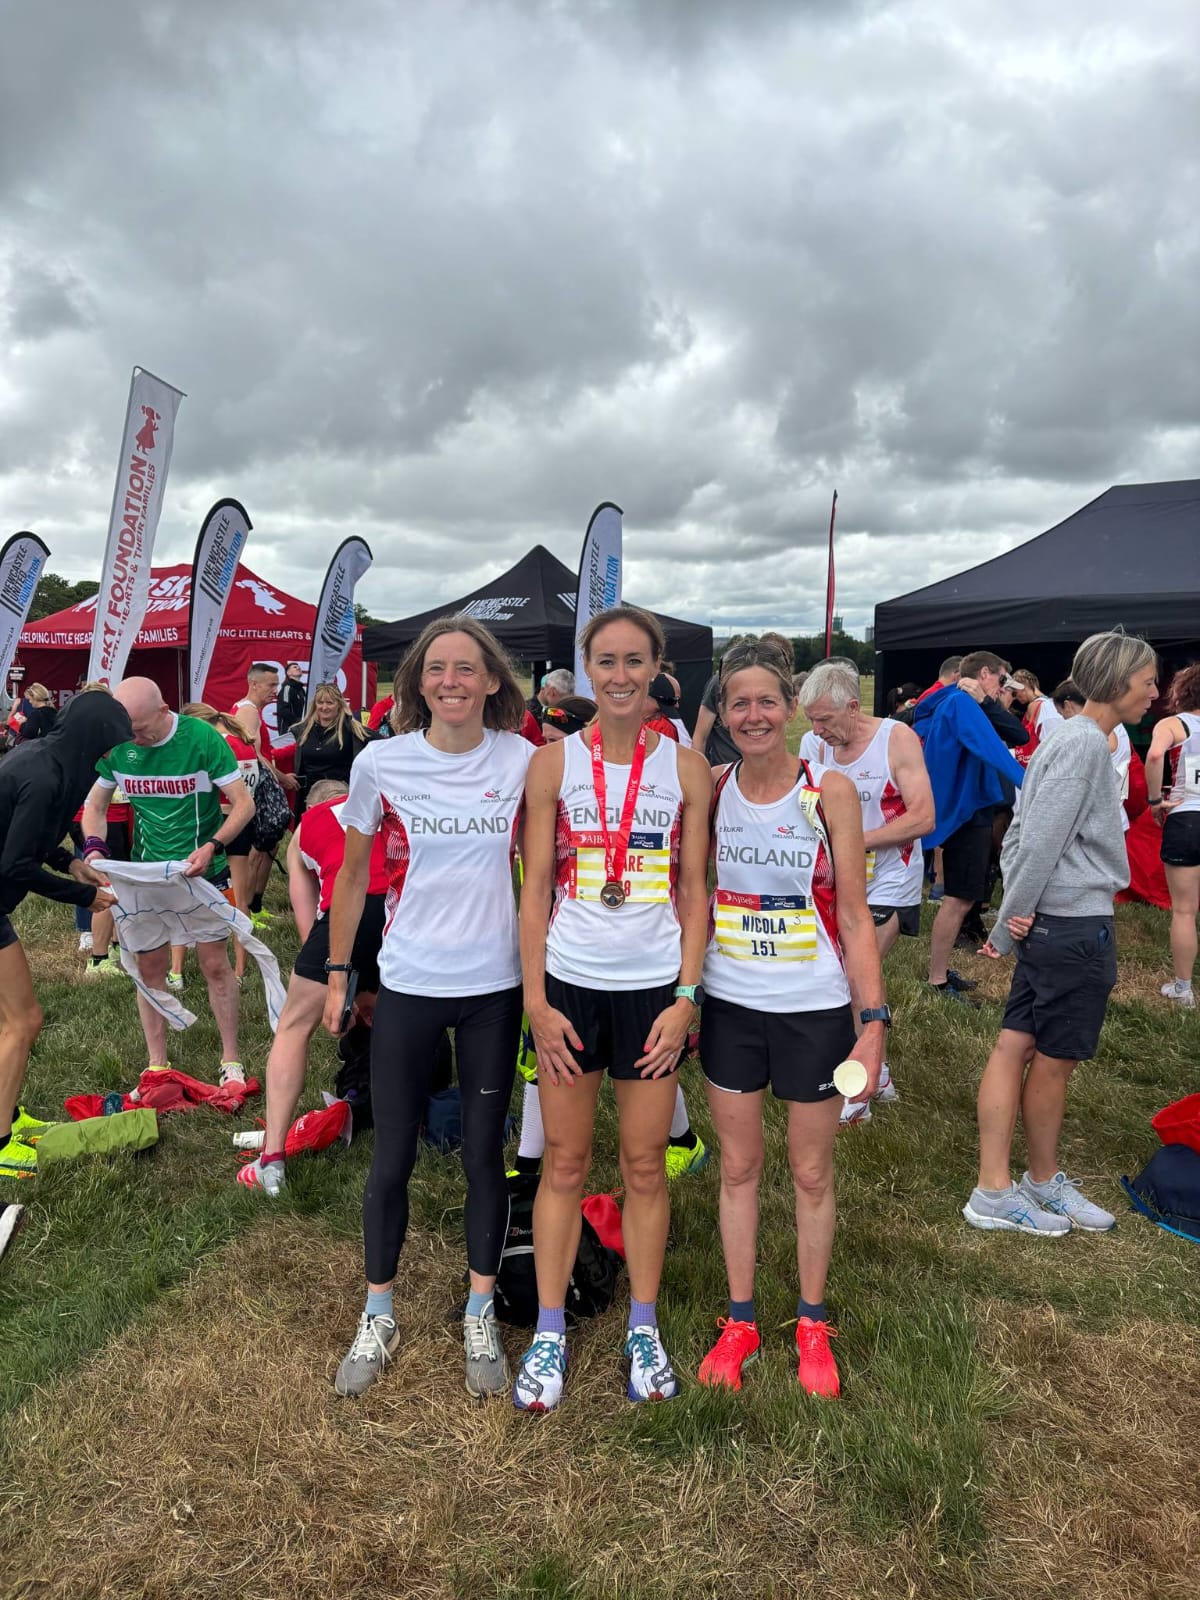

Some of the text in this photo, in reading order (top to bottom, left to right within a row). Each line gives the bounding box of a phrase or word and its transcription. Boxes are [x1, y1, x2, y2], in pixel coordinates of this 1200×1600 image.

[141, 463, 155, 519] FAMILIES
[107, 454, 147, 618] FOUNDATION
[133, 522, 145, 558] THEIR
[202, 513, 230, 578] NEWCASTLE
[2, 545, 28, 595] NEWCASTLE
[130, 562, 138, 574] &
[209, 547, 228, 586] UNITED
[217, 530, 243, 594] FOUNDATION
[588, 538, 600, 610] NEWCASTLE
[9, 569, 27, 602] UNITED
[17, 556, 42, 609] FOUNDATION
[603, 553, 619, 609] NDATION
[328, 595, 350, 633] UNITED
[51, 631, 73, 645] LITTLE
[138, 627, 178, 644] FAMILIES
[239, 629, 267, 638] LITTLE
[269, 630, 303, 640] HEARTS
[305, 632, 312, 640] &
[400, 794, 431, 802] KUKRI
[410, 816, 510, 835] ENGLAND
[718, 845, 813, 869] ENGLAND
[742, 914, 787, 935] NICOLA
[751, 939, 777, 957] 151
